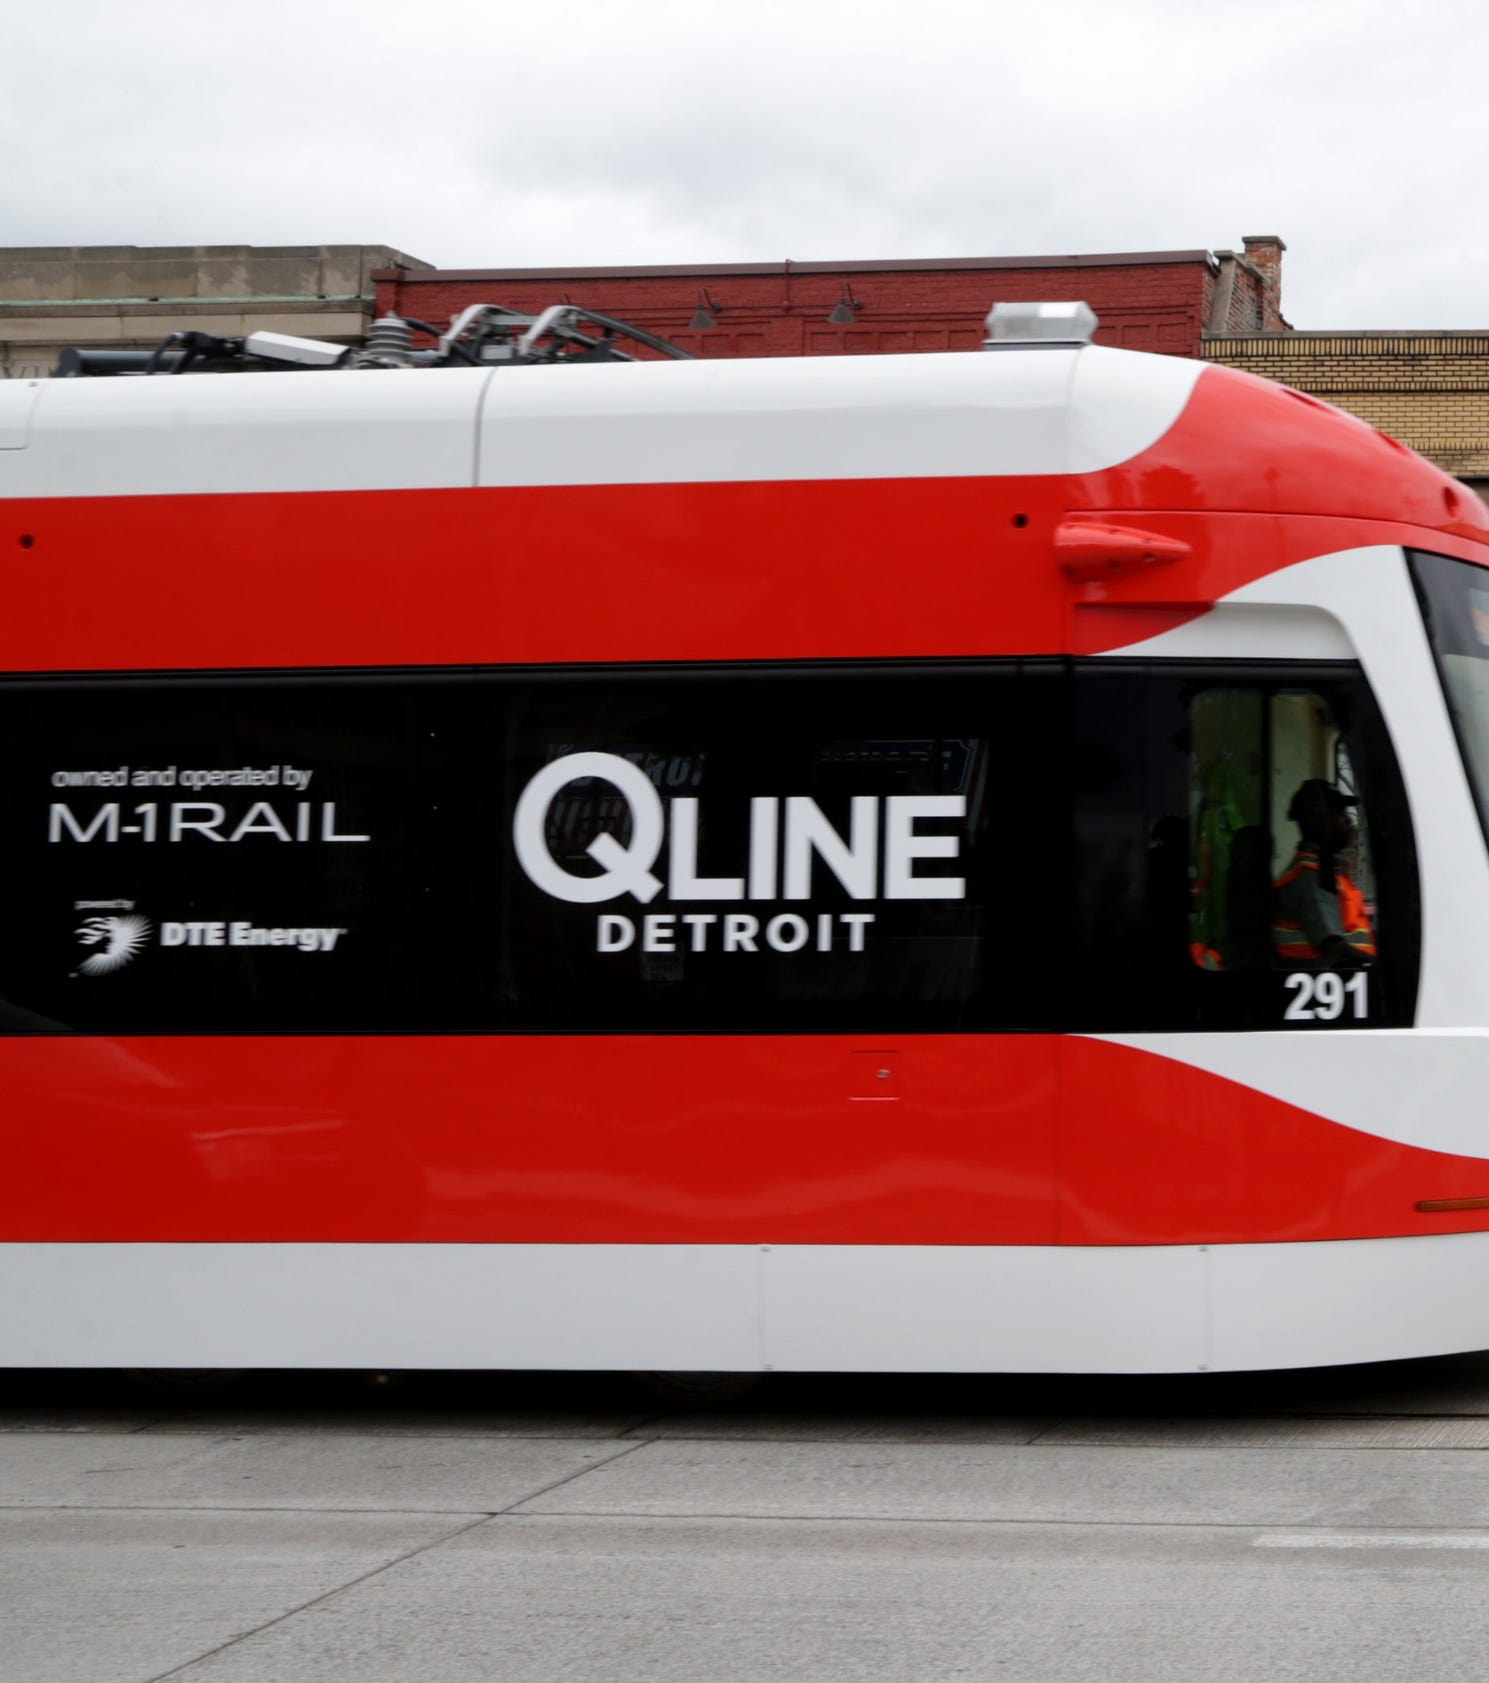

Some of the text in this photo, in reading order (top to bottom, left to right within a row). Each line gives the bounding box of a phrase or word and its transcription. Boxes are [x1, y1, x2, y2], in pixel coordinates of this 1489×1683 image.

[52, 765, 313, 790] owned and operated by
[513, 751, 967, 904] QLINE
[161, 921, 341, 951] DTE Energy
[596, 913, 876, 953] DETROIT
[1284, 971, 1369, 1020] 291
